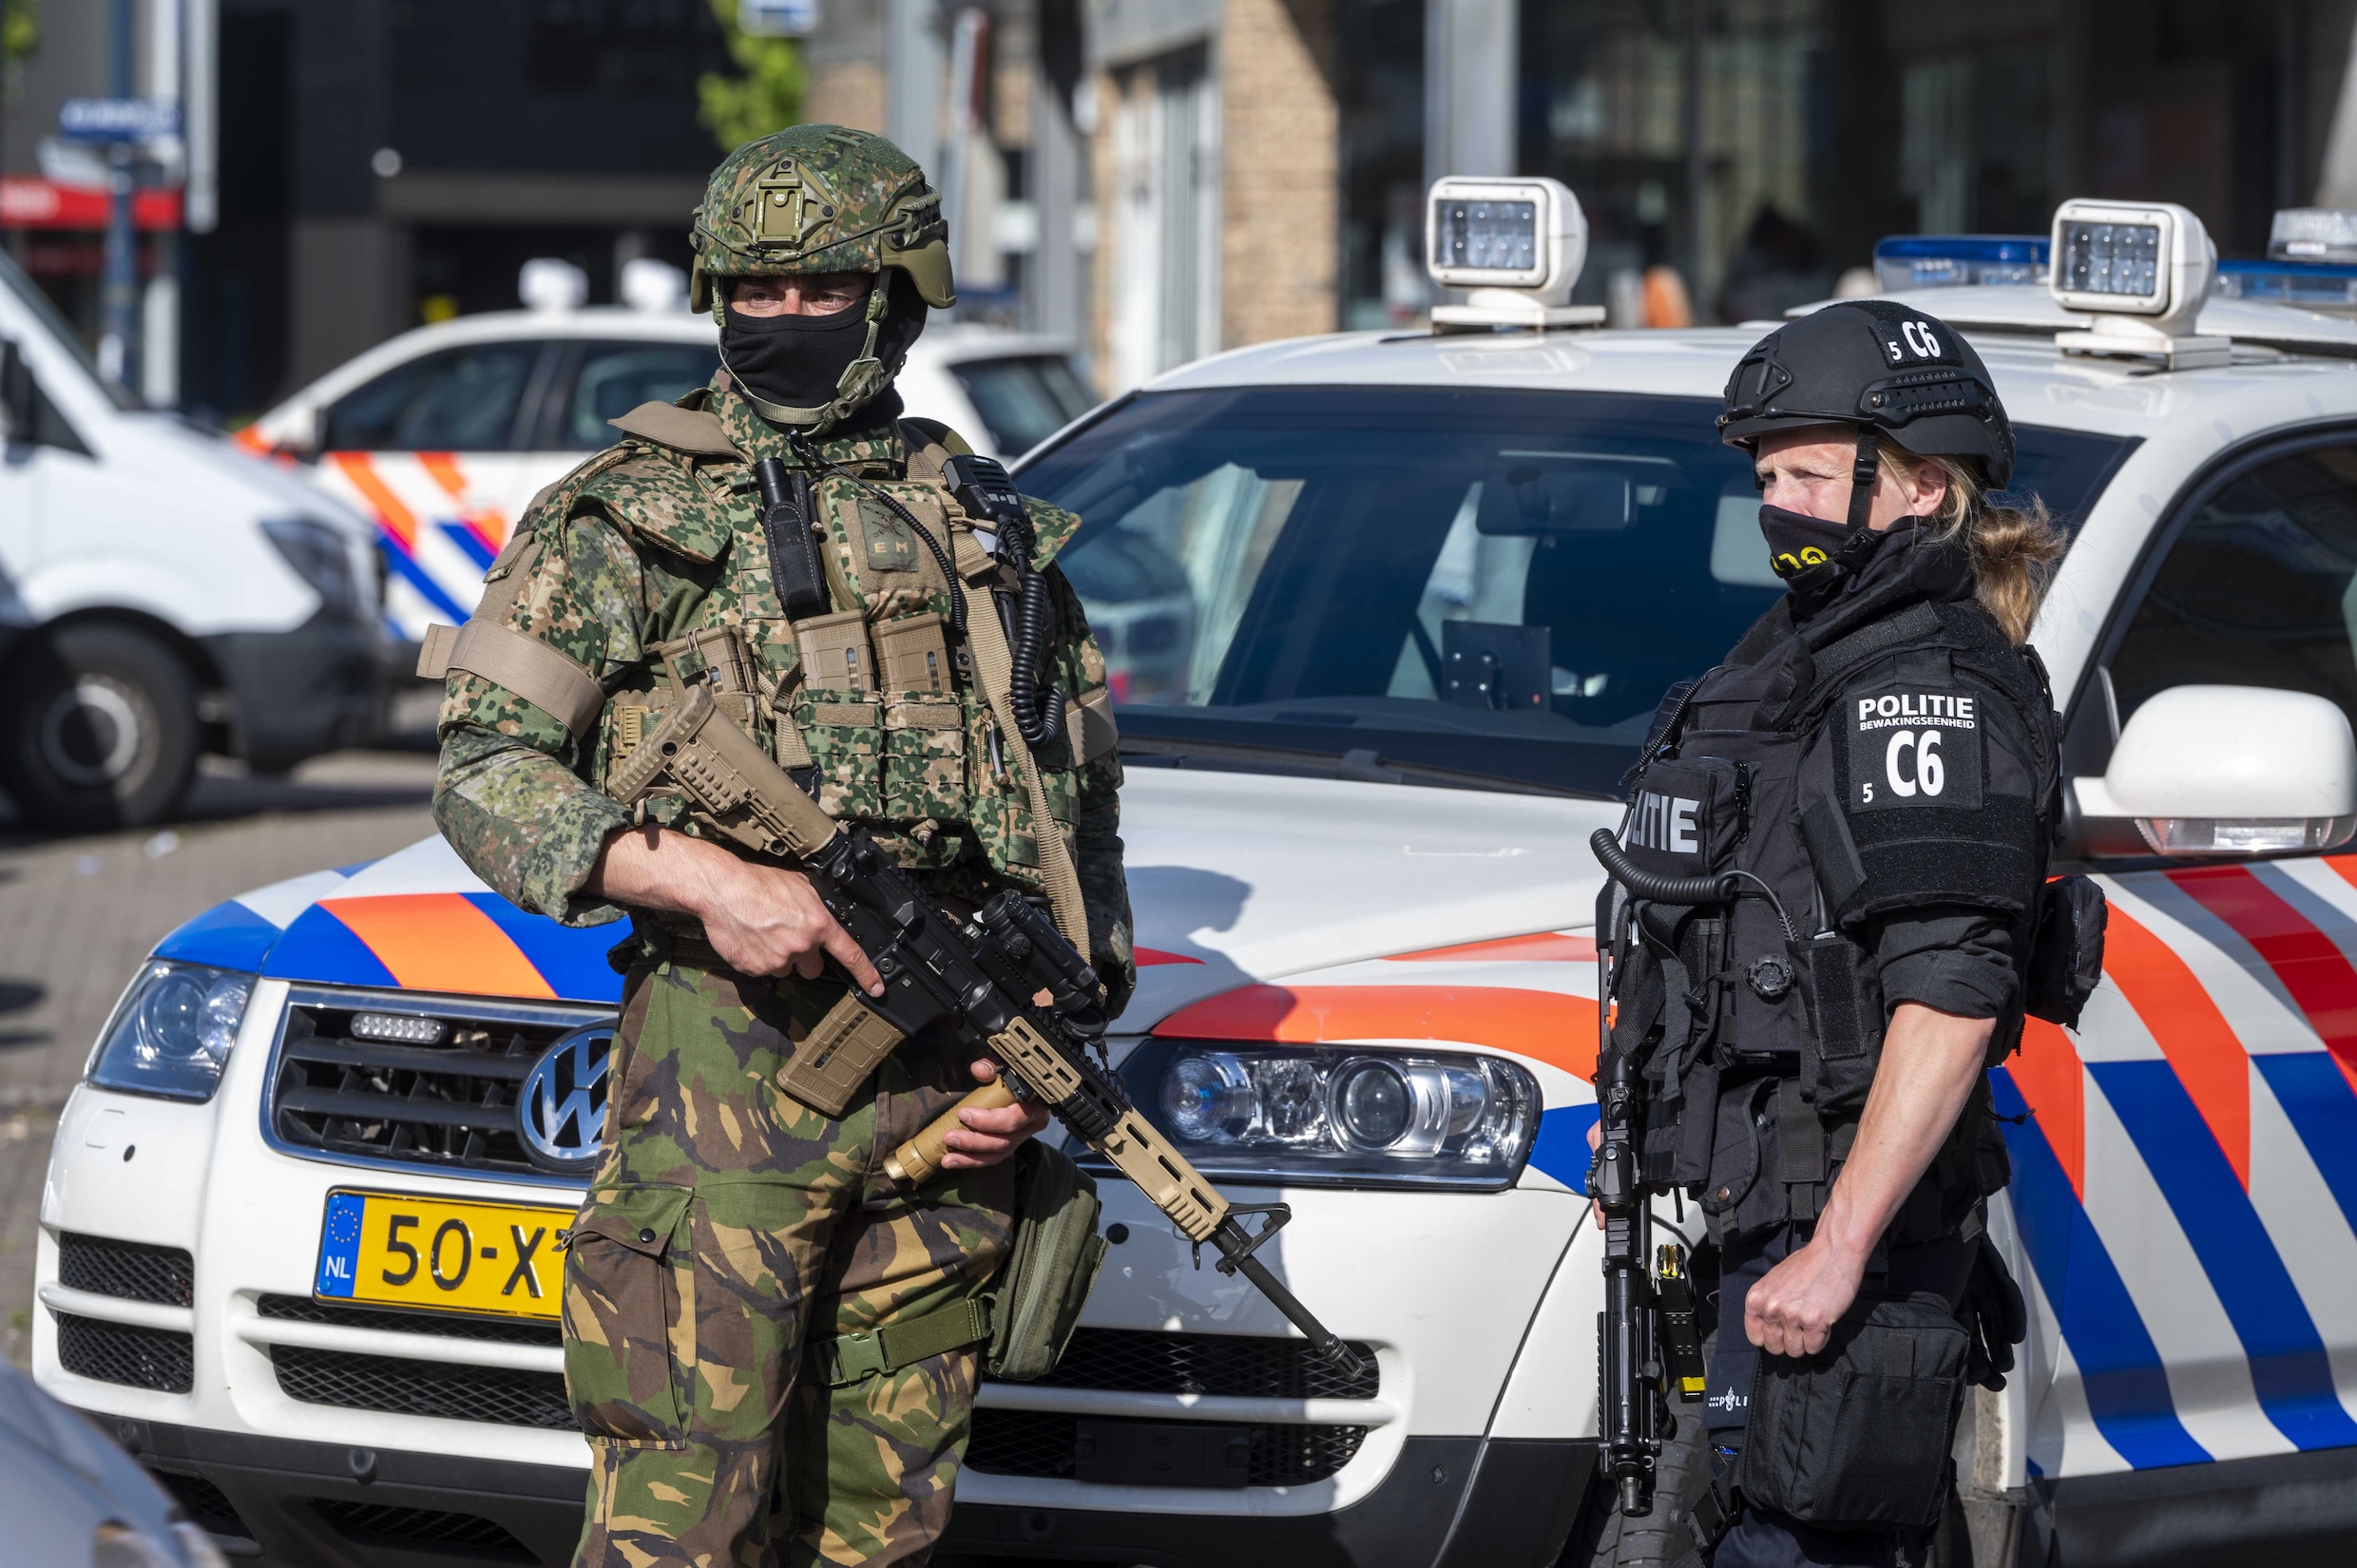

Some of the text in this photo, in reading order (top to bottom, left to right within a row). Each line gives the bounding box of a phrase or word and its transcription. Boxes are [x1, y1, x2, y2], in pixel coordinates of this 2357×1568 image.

[1888, 320, 1942, 360] 5 C6
[1858, 694, 1974, 721] POLITIE
[1859, 717, 1976, 732] BEWAKINGSEENHEID
[1862, 729, 1945, 803] 5 C6
[1628, 789, 1700, 853] LITIE
[324, 1254, 351, 1279] NL
